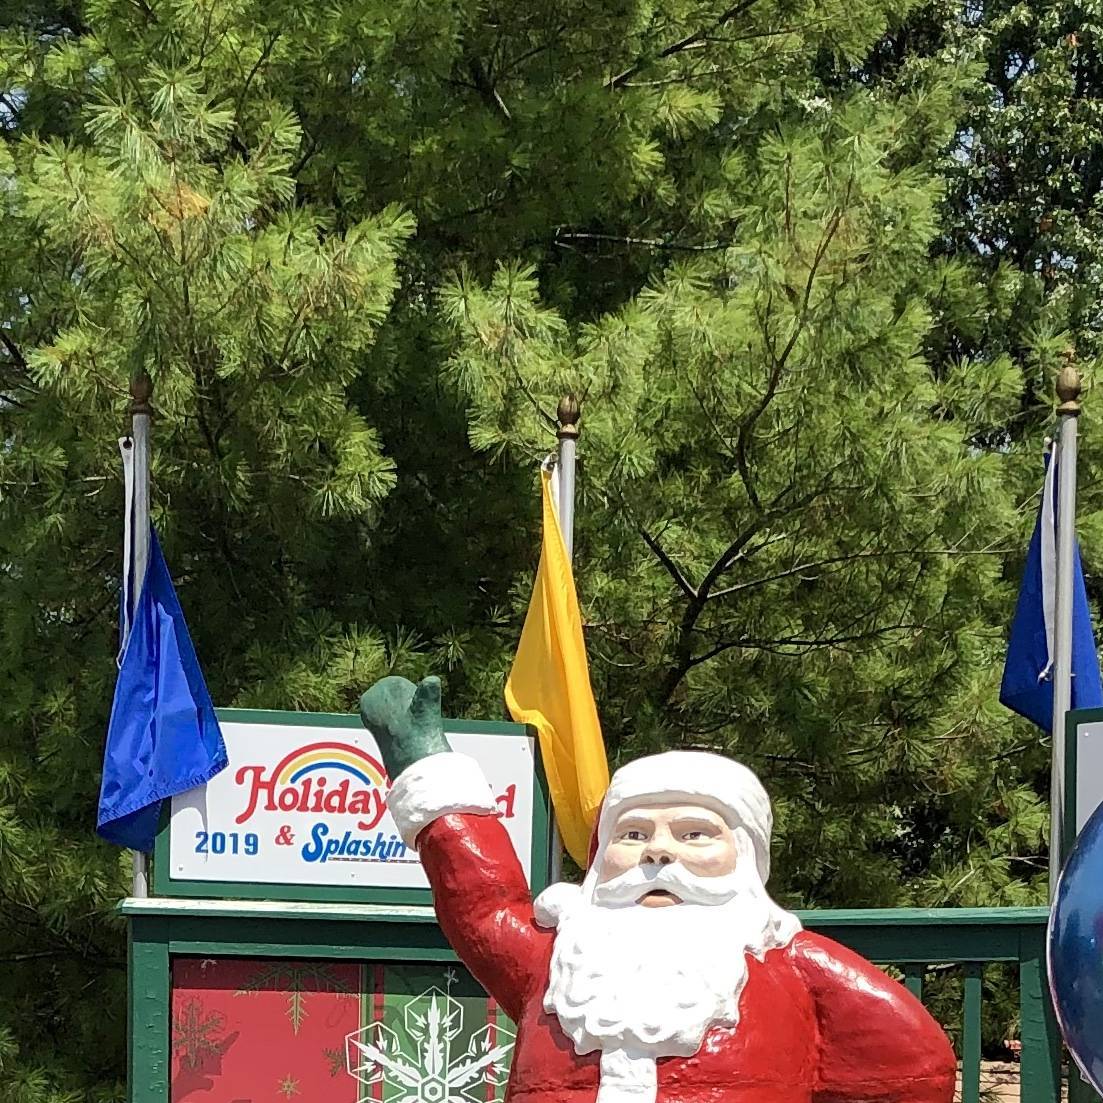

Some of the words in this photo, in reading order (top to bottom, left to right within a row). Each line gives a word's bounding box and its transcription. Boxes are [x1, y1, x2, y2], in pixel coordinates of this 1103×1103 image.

[235, 765, 388, 831] Holiday
[195, 831, 259, 856] 2019
[274, 825, 295, 846] &
[301, 822, 407, 863] Splashin
